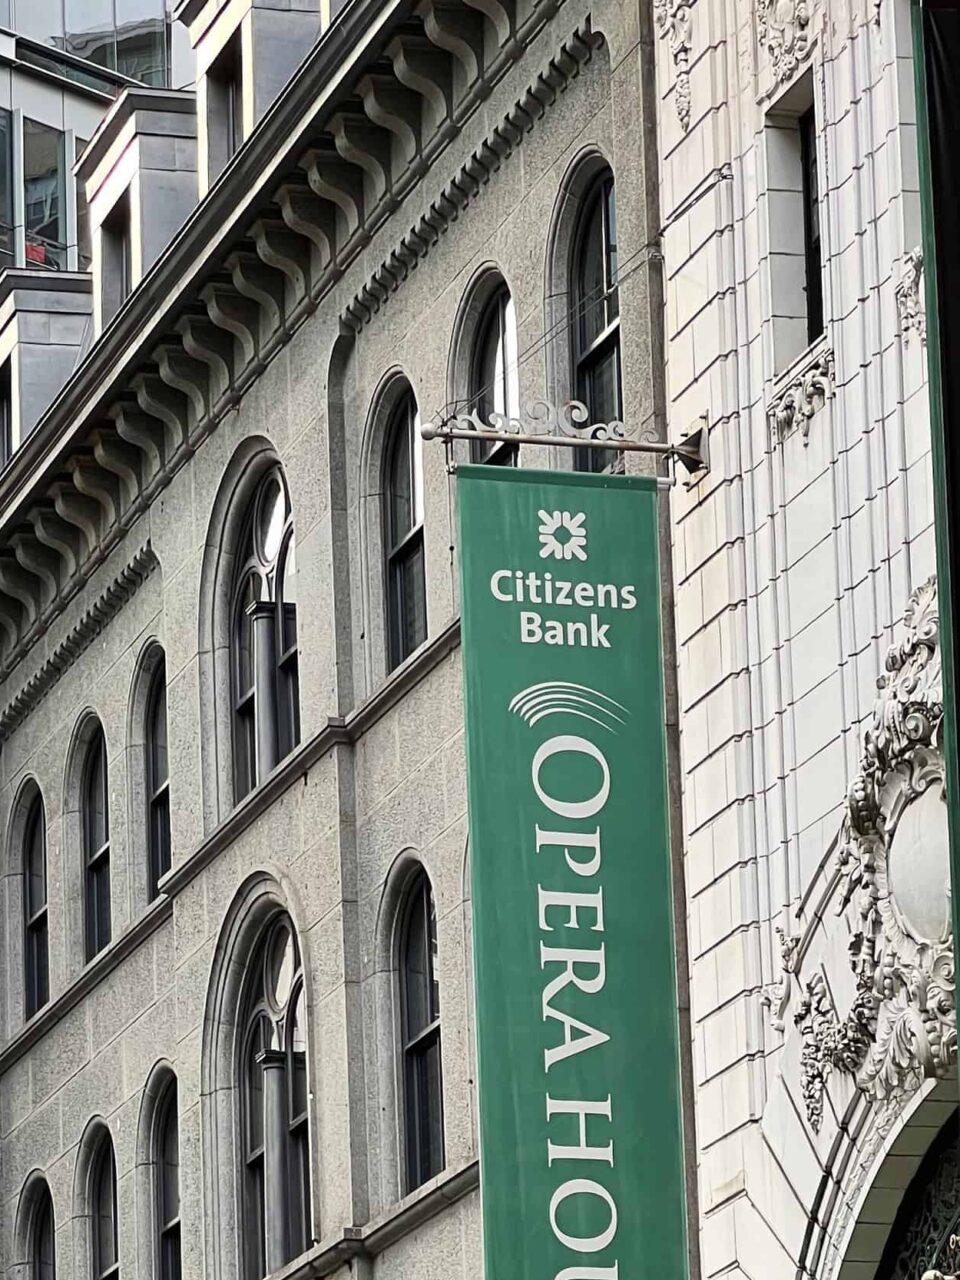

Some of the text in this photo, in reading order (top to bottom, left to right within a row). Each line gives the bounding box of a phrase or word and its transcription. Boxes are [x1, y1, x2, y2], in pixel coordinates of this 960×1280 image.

[490, 569, 638, 610] Citizens
[519, 611, 611, 648] Bank
[531, 734, 611, 1074] OPERA
